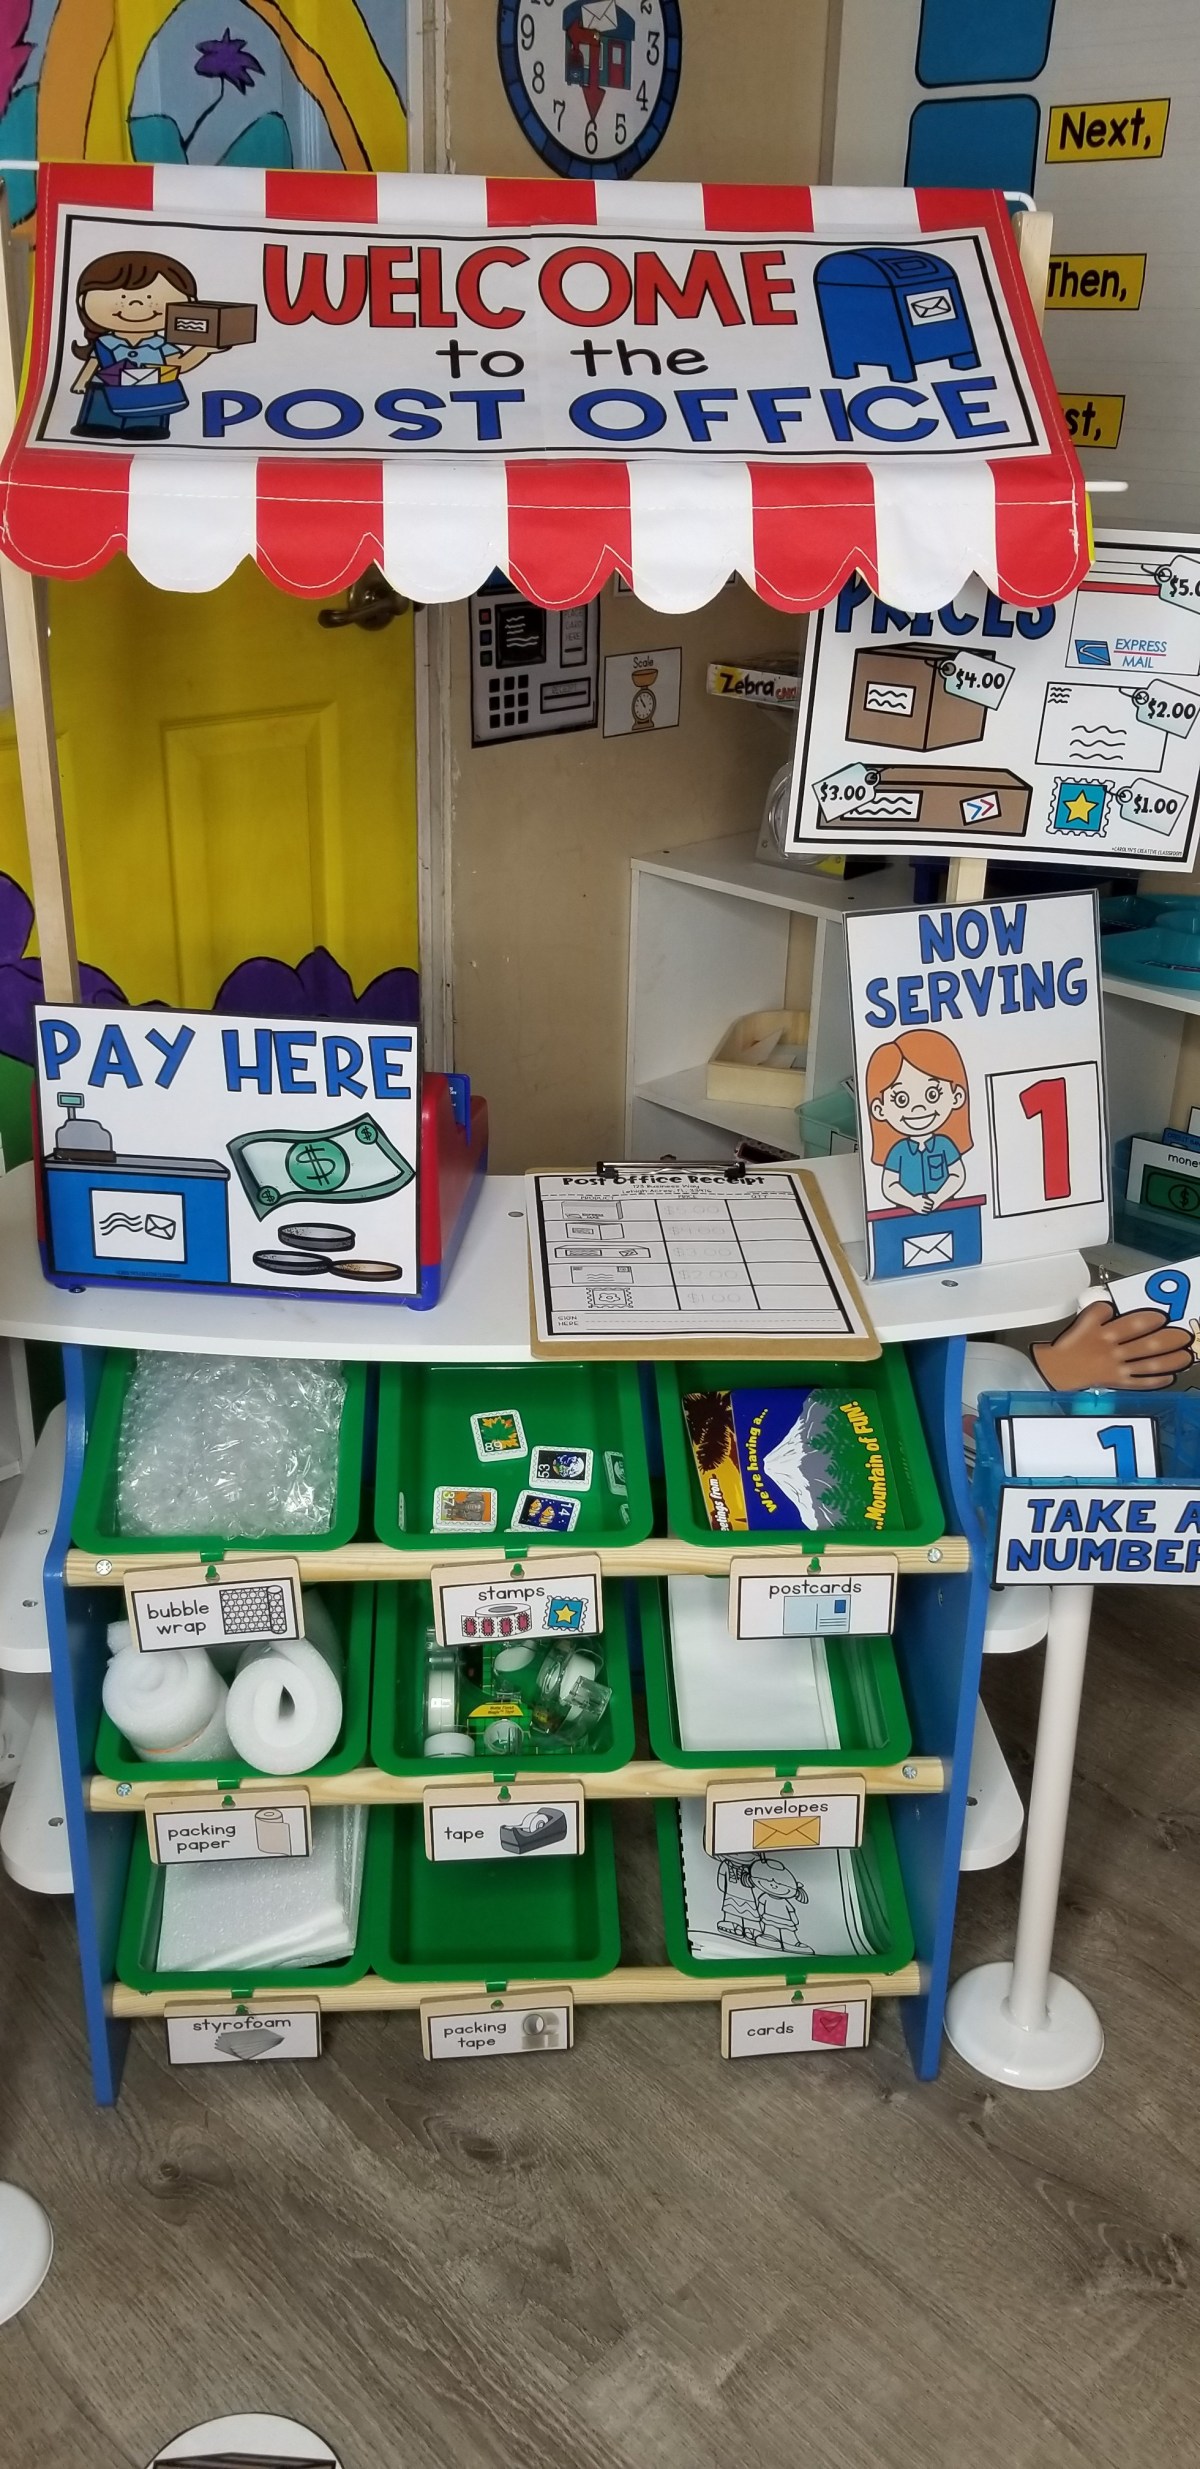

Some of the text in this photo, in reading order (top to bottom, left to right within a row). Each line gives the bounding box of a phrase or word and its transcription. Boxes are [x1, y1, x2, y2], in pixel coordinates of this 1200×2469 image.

[520, 14, 535, 51] 9
[646, 31, 660, 66] 3
[532, 61, 545, 94] 8
[636, 80, 648, 111] 4
[553, 99, 566, 132] 7
[584, 119, 598, 154] 6
[614, 113, 627, 145] 5
[1059, 111, 1151, 151] Next,
[263, 243, 798, 329] WELCOME
[1048, 261, 1127, 302] Then,
[436, 338, 709, 378] to the
[202, 376, 1010, 443] POST OFFICE
[1064, 402, 1101, 441] st,
[1115, 638, 1168, 653] EXPRESS
[633, 655, 654, 669] Scale
[1122, 656, 1154, 668] MAIL
[720, 672, 775, 697] Zebra
[956, 668, 1005, 690] $4.00
[1148, 698, 1196, 719] $2.00
[820, 782, 866, 802] $3.00
[1133, 793, 1178, 815] $1.00
[918, 903, 1028, 964] NOW
[865, 957, 1088, 1029] SERVING
[39, 1018, 413, 1099] PAY HERE
[1019, 1076, 1071, 1201] 1
[1168, 1153, 1200, 1168] mone
[1144, 1269, 1191, 1323] 9
[484, 1440, 503, 1452] 89
[746, 1427, 761, 1471] having
[858, 1436, 880, 1451] of
[1097, 1425, 1138, 1478] 1
[538, 1464, 550, 1478] 53
[710, 1478, 722, 1499] from
[752, 1474, 777, 1513] We're
[558, 1502, 572, 1516] 14
[1027, 1498, 1200, 1533] TAKE A
[478, 1585, 545, 1602] stamps
[769, 1577, 862, 1599] postcards
[146, 1599, 210, 1620] bubble
[156, 1621, 207, 1636] wrap
[744, 1801, 829, 1818] envelopes
[168, 1822, 236, 1841] packing
[444, 1826, 485, 1843] tape
[177, 1840, 231, 1855] paper
[193, 2016, 292, 2034] styrofoam
[443, 2021, 507, 2038] packing
[747, 2021, 795, 2037] cards
[457, 2036, 496, 2050] tape
